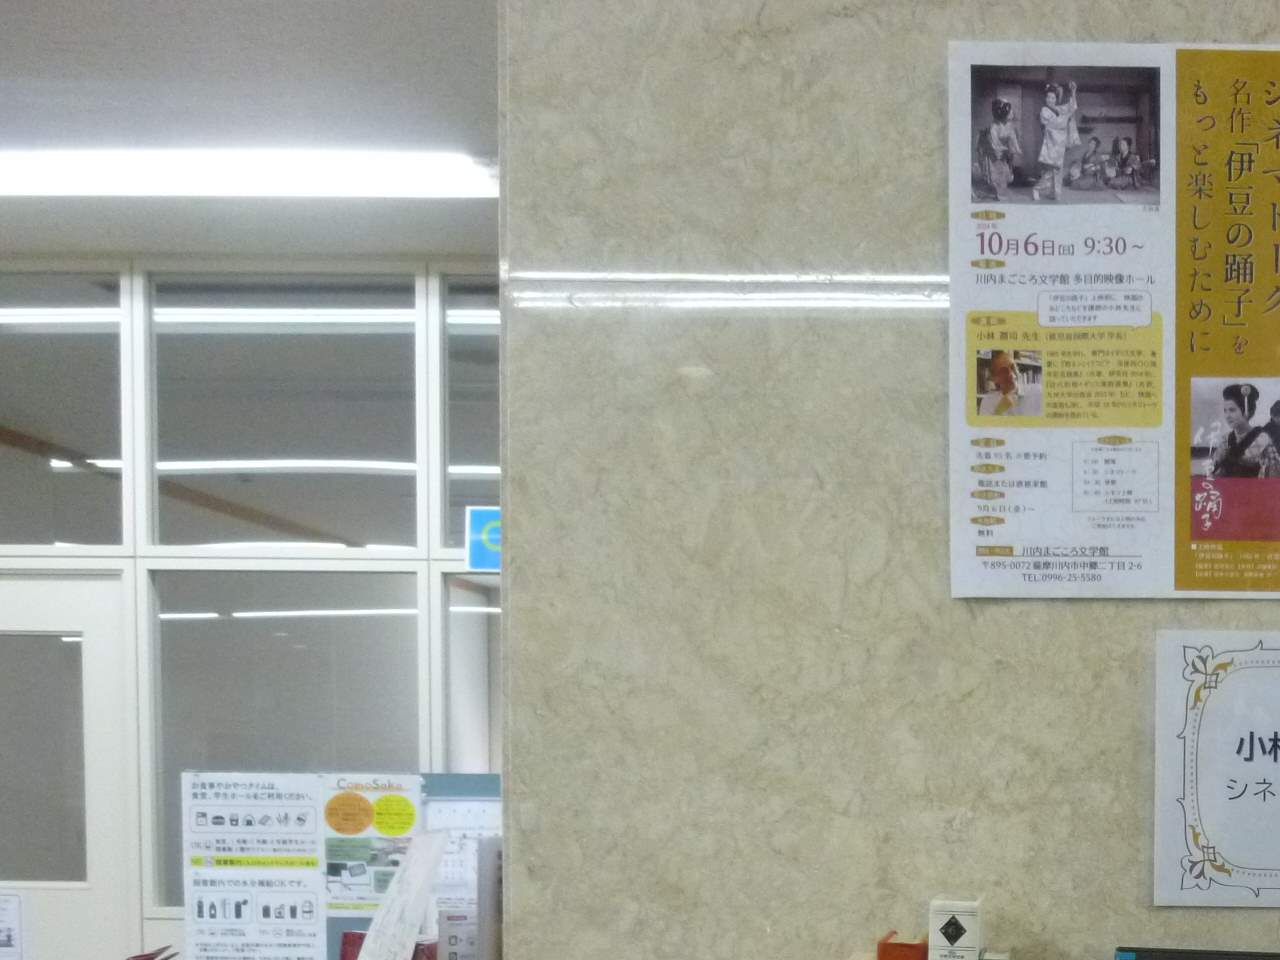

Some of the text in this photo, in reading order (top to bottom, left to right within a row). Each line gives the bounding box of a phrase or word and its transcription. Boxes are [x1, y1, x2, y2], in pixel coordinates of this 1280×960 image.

[976, 273, 1070, 285] 川内まごころ文学館
[1189, 80, 1216, 352] もっと楽しむために
[1223, 78, 1259, 354] 名作「伊豆の踊子」を
